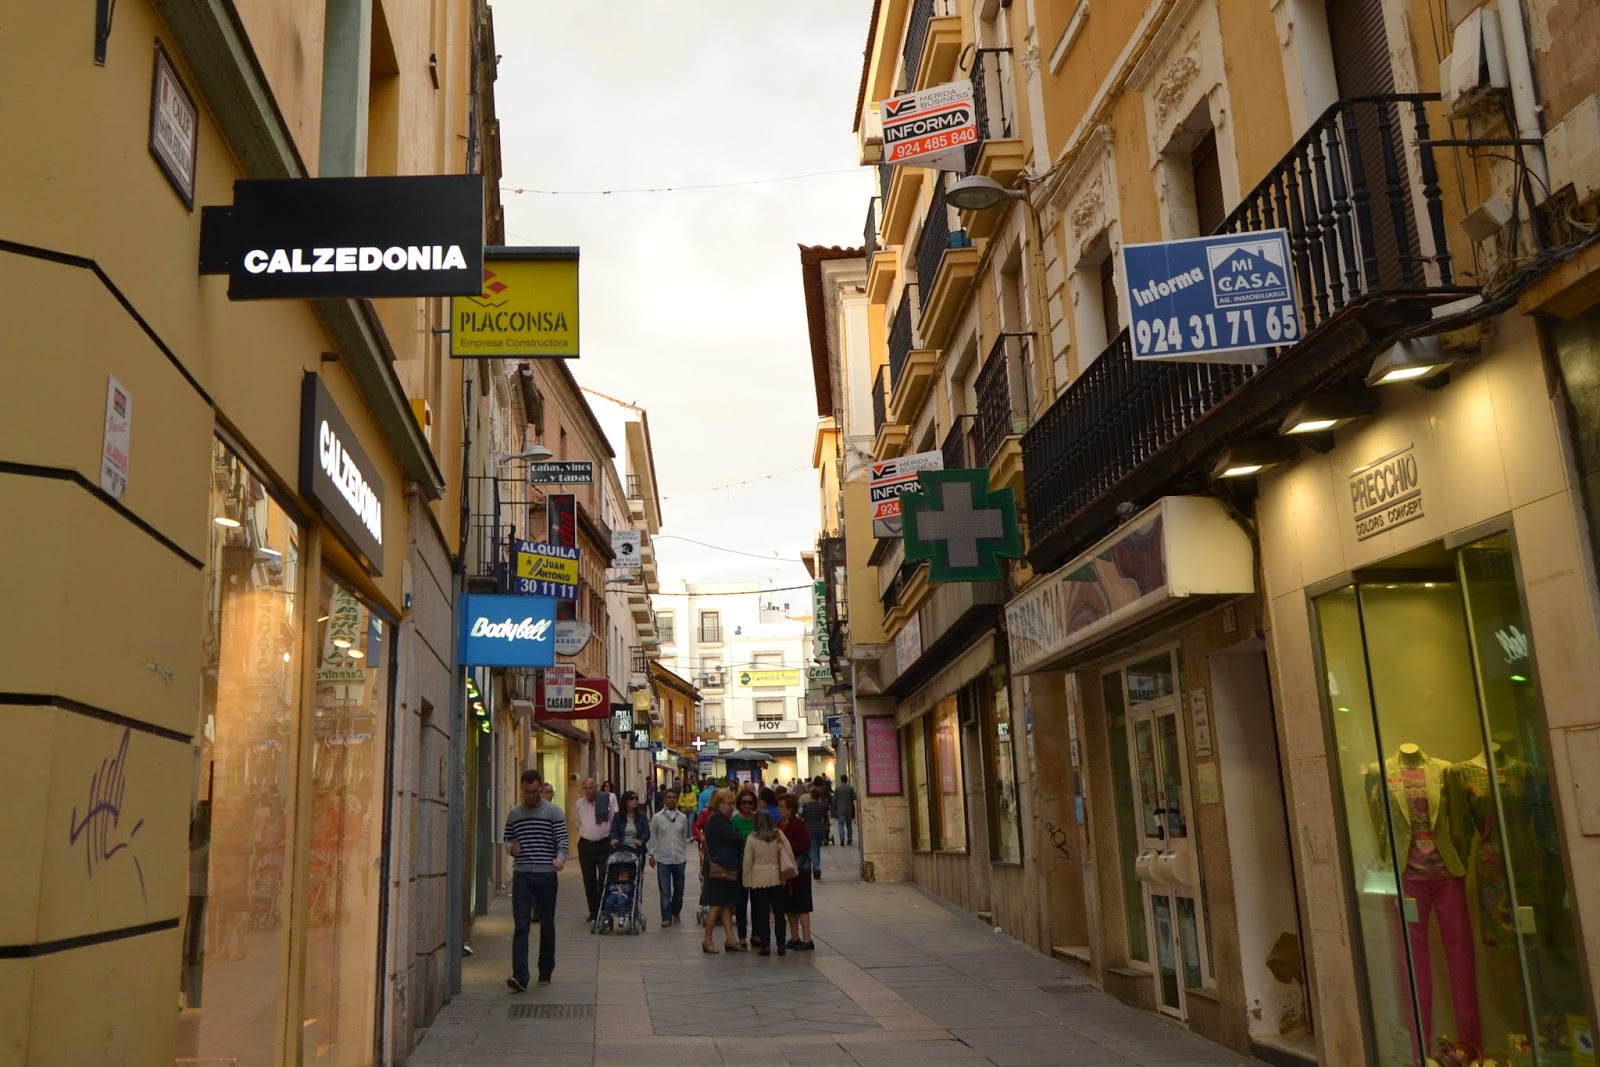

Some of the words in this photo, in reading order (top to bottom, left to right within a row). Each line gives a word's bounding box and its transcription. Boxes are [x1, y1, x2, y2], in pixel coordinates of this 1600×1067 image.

[920, 89, 957, 101] MERIDA
[920, 91, 969, 108] BUSINESS
[886, 112, 967, 141] INFORMA
[897, 141, 921, 158] 924
[924, 135, 948, 150] 485
[951, 128, 975, 144] 840
[243, 245, 467, 274] CALZEDONIA
[1232, 258, 1253, 273] MI
[1132, 267, 1205, 307] Informa
[1218, 271, 1281, 292] CASA
[1219, 297, 1232, 305] AG.
[1233, 291, 1286, 302] INMOBILIARIA
[460, 311, 569, 332] PLACONSA
[1136, 317, 1183, 354] 924
[1189, 313, 1218, 349] 31
[1226, 309, 1256, 345] 71
[1266, 304, 1297, 341] 65
[460, 338, 503, 350] Empresa
[505, 337, 569, 348] Constructora
[566, 463, 591, 471] vinos
[900, 457, 929, 468] MERIDA
[900, 461, 939, 474] BUSINESS
[319, 420, 382, 545] CALZEDONIA
[558, 474, 590, 482] tapas
[1349, 453, 1418, 513] PRECCHIO
[873, 482, 923, 500] INFORM
[880, 503, 900, 516] 924
[1356, 515, 1384, 536] COLORS
[1388, 498, 1422, 523] CONCEPT
[521, 541, 576, 559] ALQUILA
[543, 559, 565, 570] JUAN
[534, 568, 570, 582] ANTONIO
[520, 578, 537, 593] 30
[541, 581, 556, 596] 11
[560, 584, 574, 599] 11
[470, 617, 552, 641] Bodybell
[546, 677, 573, 685] CABALLEROS
[547, 698, 572, 709] CASADO
[575, 693, 598, 704] LOS
[620, 724, 631, 732] EAR
[759, 722, 780, 730] HOY
